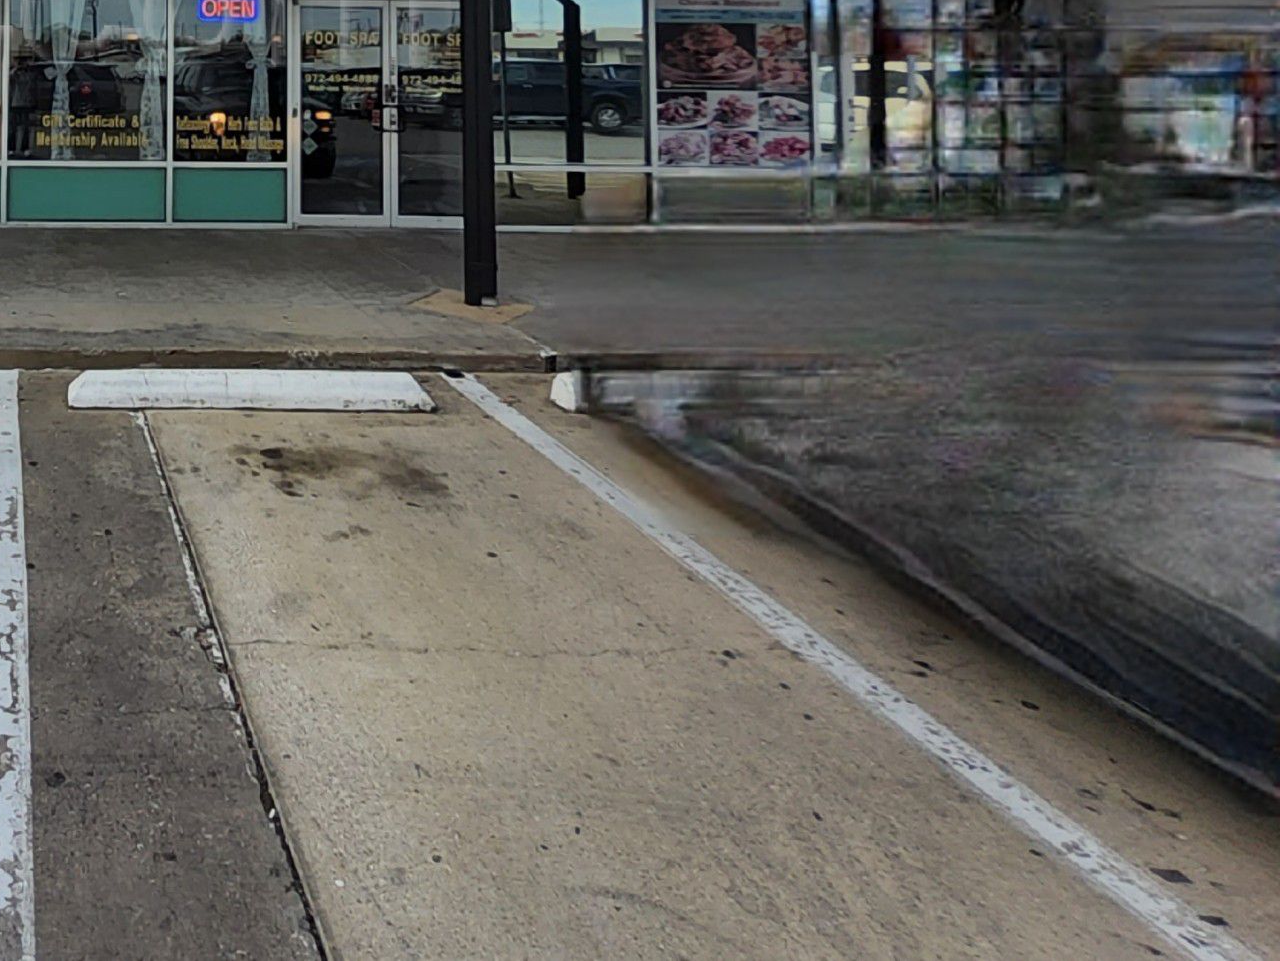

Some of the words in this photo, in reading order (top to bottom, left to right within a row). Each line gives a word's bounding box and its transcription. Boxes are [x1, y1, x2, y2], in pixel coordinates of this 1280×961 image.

[305, 30, 341, 46] FOOT
[402, 32, 443, 48] FOOT
[67, 115, 127, 128] Certificate
[131, 115, 140, 128] &
[35, 131, 97, 149] Membership
